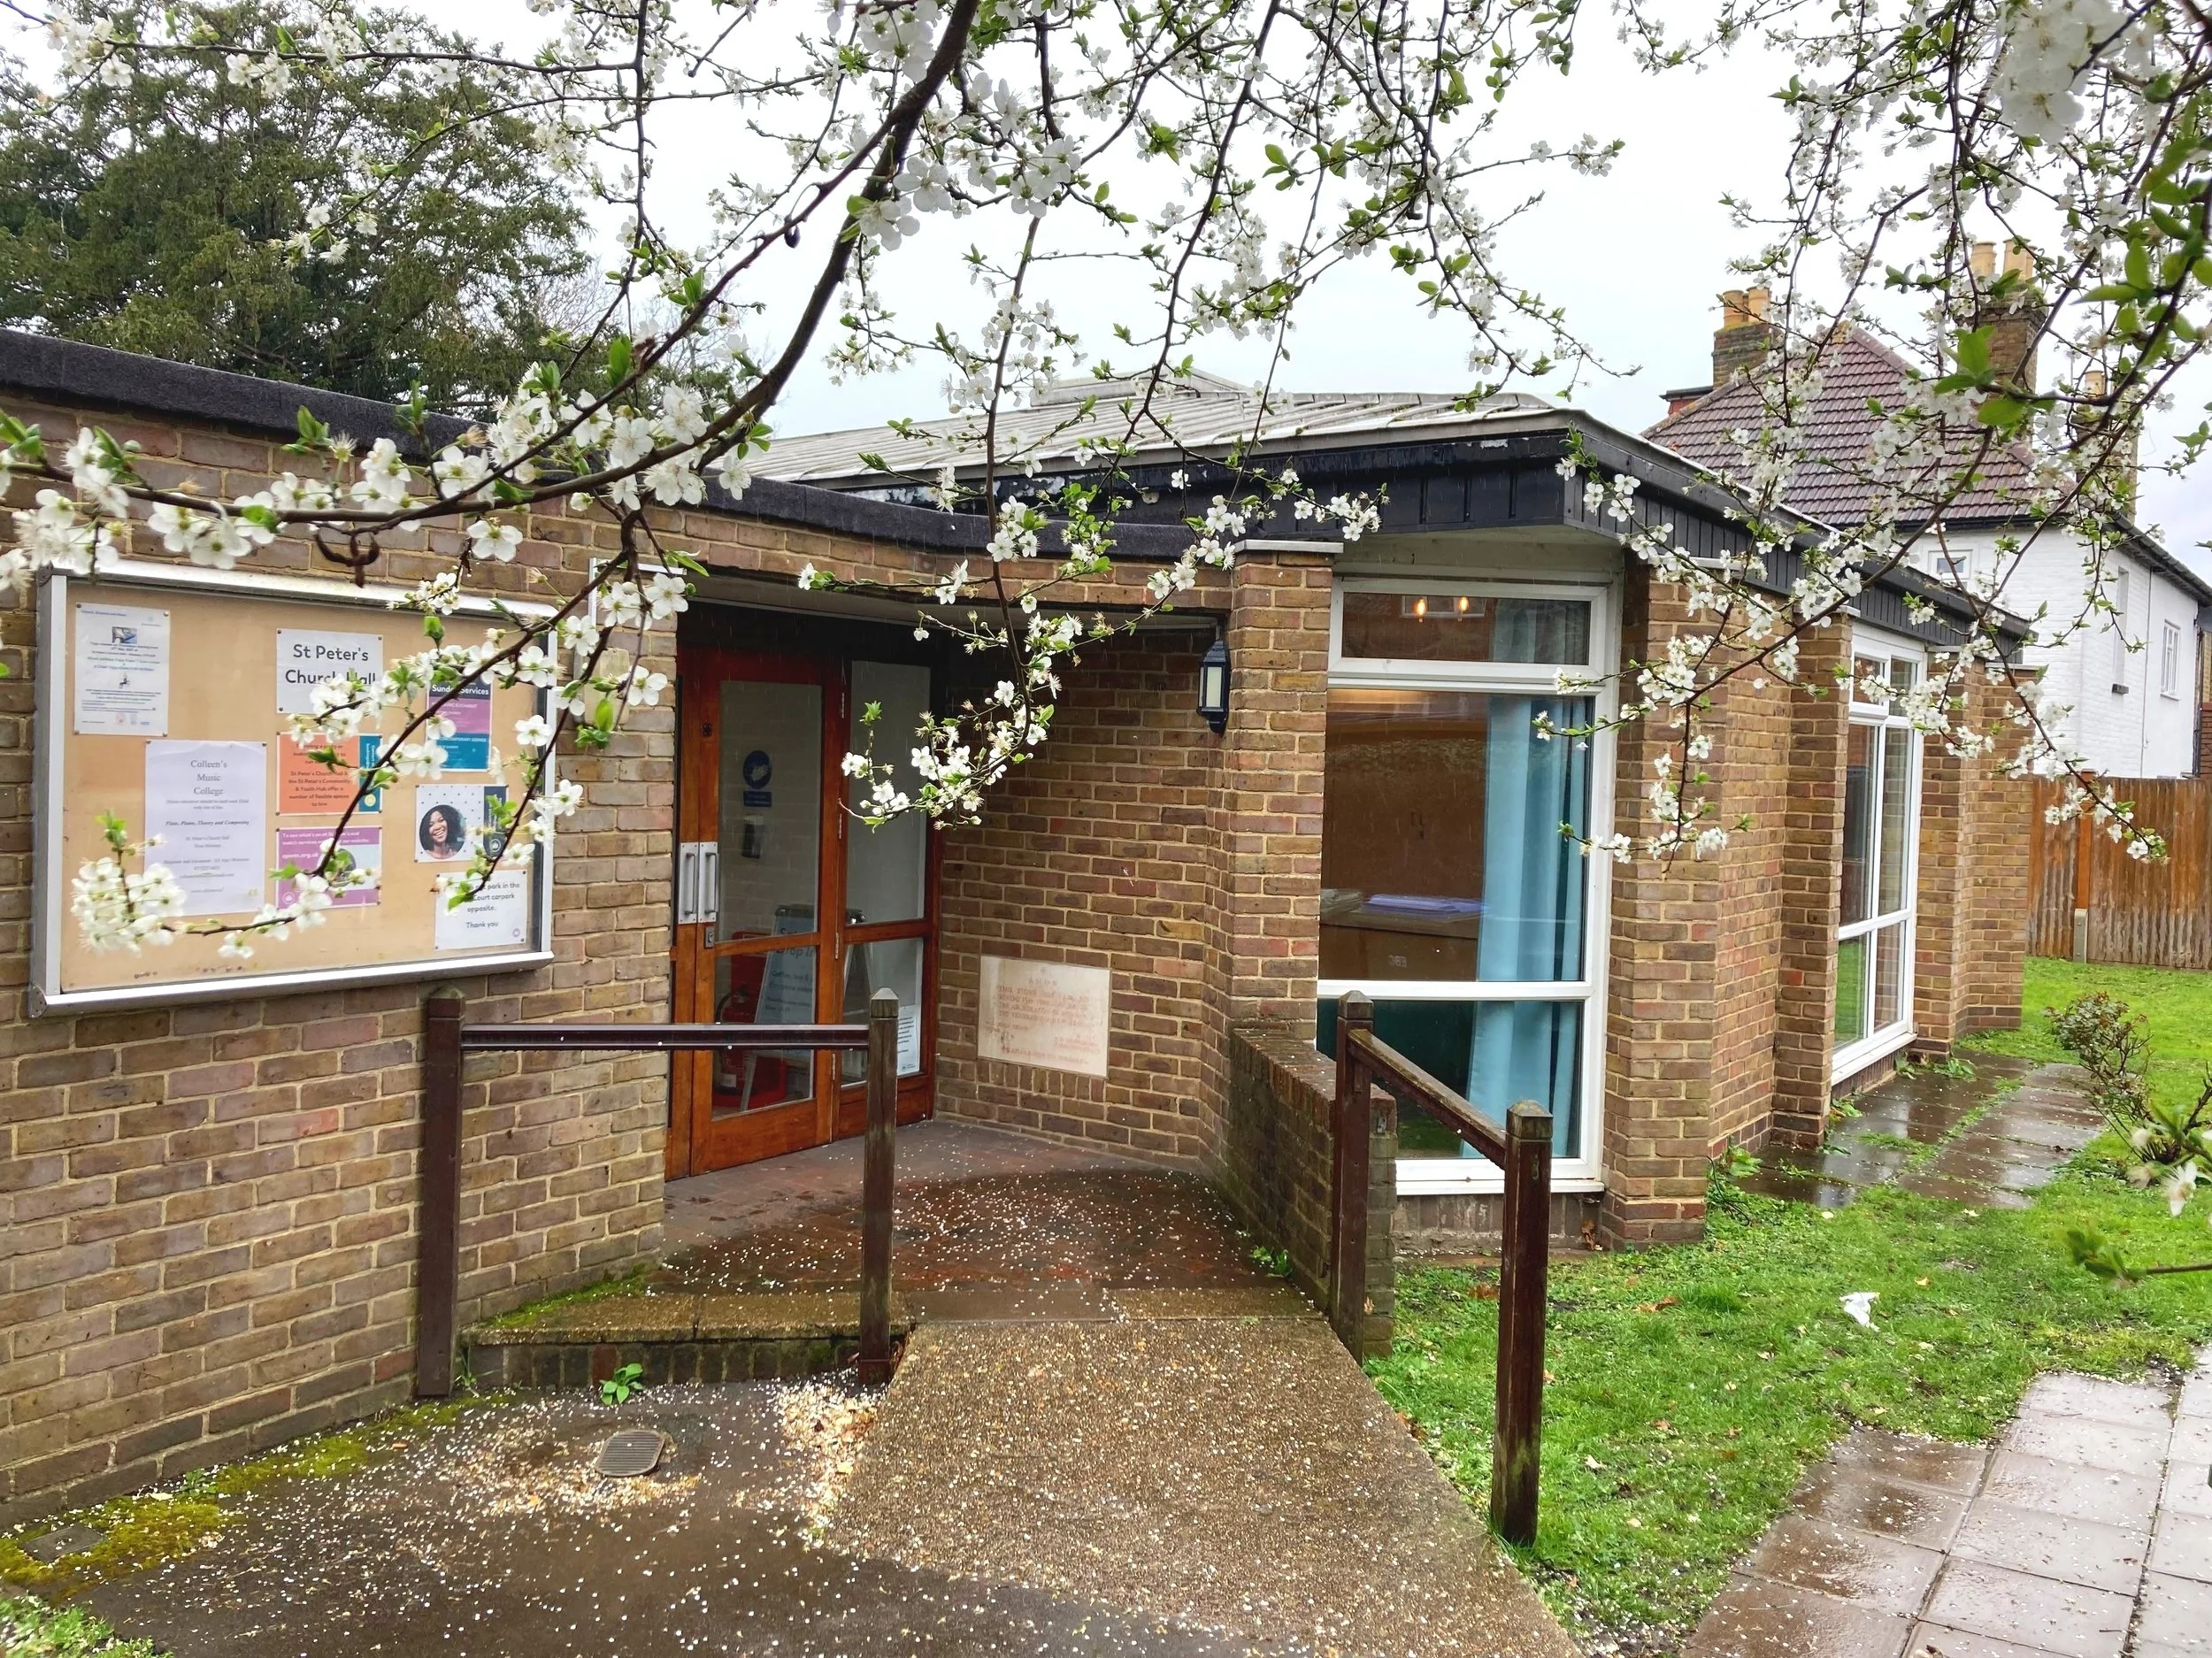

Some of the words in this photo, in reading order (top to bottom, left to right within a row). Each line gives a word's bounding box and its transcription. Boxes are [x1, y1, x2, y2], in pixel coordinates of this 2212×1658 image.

[293, 643, 311, 658] St
[316, 645, 369, 662] Peter's
[432, 684, 457, 693] Sund
[190, 759, 227, 768] Colleen's
[194, 787, 223, 796] College
